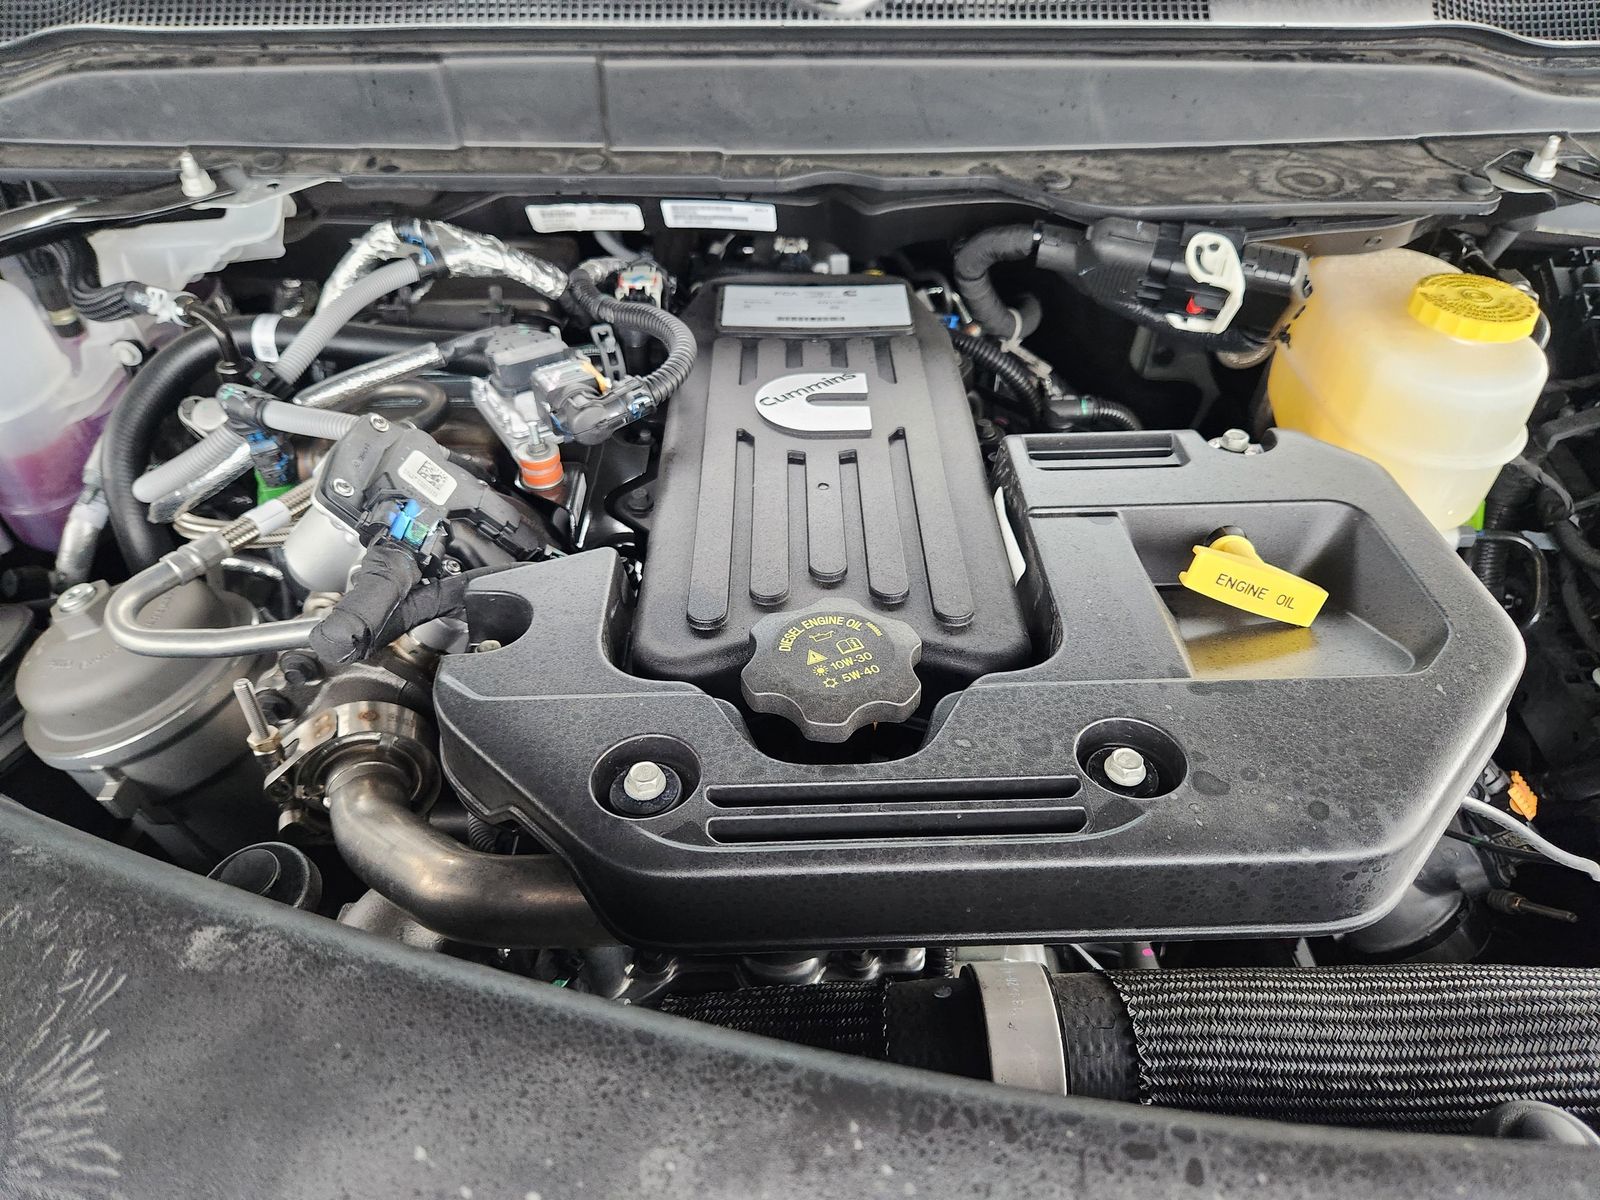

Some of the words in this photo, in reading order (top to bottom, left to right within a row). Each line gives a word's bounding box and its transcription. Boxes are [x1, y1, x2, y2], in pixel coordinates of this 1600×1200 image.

[758, 372, 857, 407] Cummins
[1215, 573, 1270, 600] ENGINE
[1276, 594, 1295, 610] OIL
[778, 626, 805, 652] DIESEL
[801, 616, 845, 630] ENGINE
[845, 618, 864, 632] OIL
[830, 651, 873, 671] 10W-30
[841, 664, 880, 683] 5W-40
